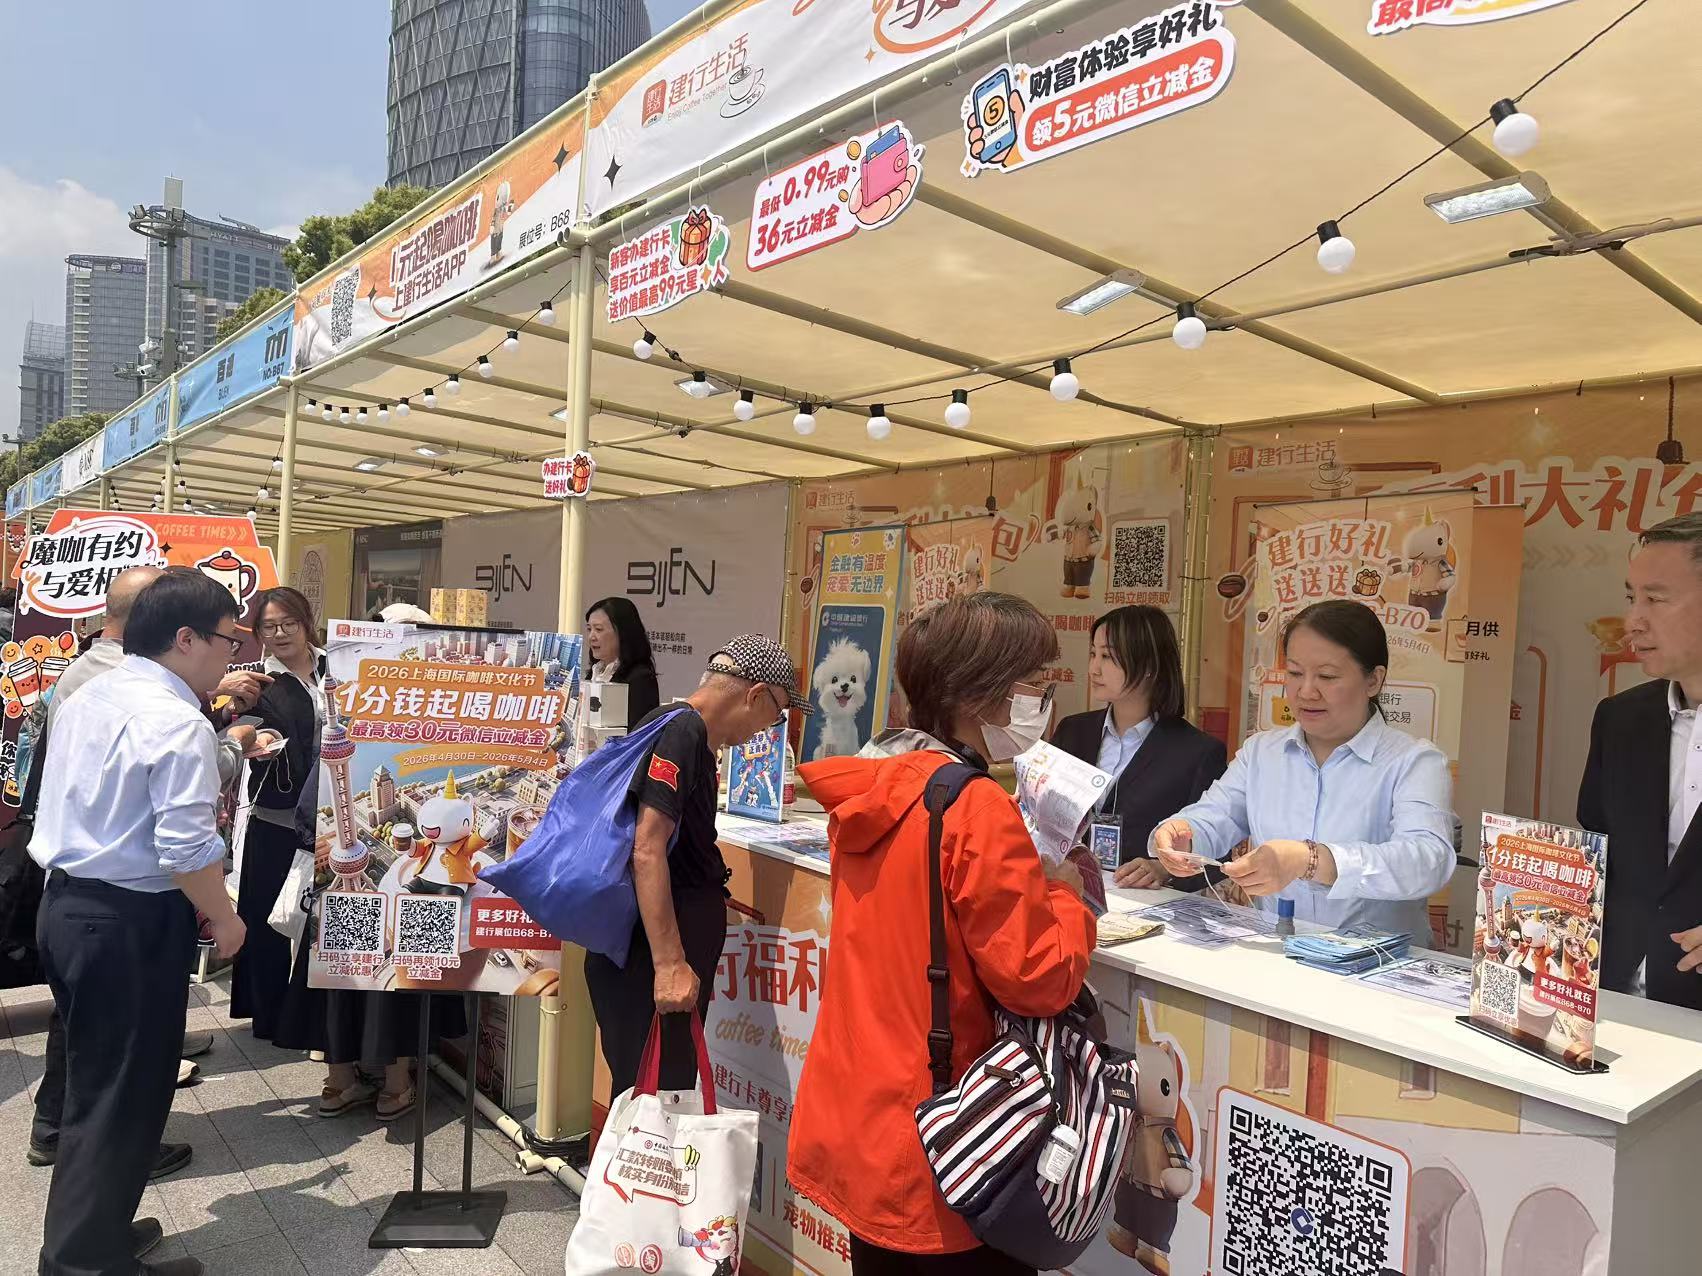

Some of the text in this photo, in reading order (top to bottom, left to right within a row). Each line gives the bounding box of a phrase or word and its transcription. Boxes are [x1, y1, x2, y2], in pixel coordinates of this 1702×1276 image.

[668, 33, 749, 106] 建行生活
[1029, 3, 1216, 102] 财富体验享好礼
[989, 101, 998, 120] 5
[1032, 56, 1215, 146] 领5元微信立减金
[759, 160, 849, 219] 最低0.99元购
[390, 199, 480, 283] 1元起喝咖啡
[754, 203, 839, 256] 36元立减金
[610, 228, 671, 271] 新客办建行卡
[391, 250, 467, 312] 上建行生活APP
[609, 255, 671, 294] 享百元立减金
[1257, 440, 1336, 467] 建行生活
[29, 530, 143, 566] 魔咖有约
[156, 523, 228, 539] COFFEE TIME
[1266, 522, 1391, 569] 建行好礼
[831, 553, 886, 573] 金融有温度
[913, 544, 959, 579] 建行好礼
[826, 574, 885, 593] 宠爱无边界
[915, 576, 945, 606] 送送送
[1104, 591, 1171, 604] 扫码立即领取
[1275, 564, 1349, 603] 送送送
[352, 627, 393, 639] 建行生活
[1047, 613, 1096, 632] 喝咖啡
[367, 665, 537, 687] 2026上海国际咖啡文化节
[338, 684, 562, 725] 1分钱起喝咖啡
[351, 719, 547, 747] 最高领30元微信立减金
[1489, 846, 1592, 888] 1分钱起喝咖啡
[476, 927, 552, 938] 建行展位B68-B
[318, 952, 384, 965] 扫码立享建行
[329, 965, 373, 977] 立减优惠
[391, 955, 459, 968] 扫码再领10元
[408, 968, 441, 980] 立减金
[715, 1012, 764, 1046] coffee
[714, 1063, 794, 1127] 建行卡尊享
[783, 1199, 851, 1263] 宠物推车
